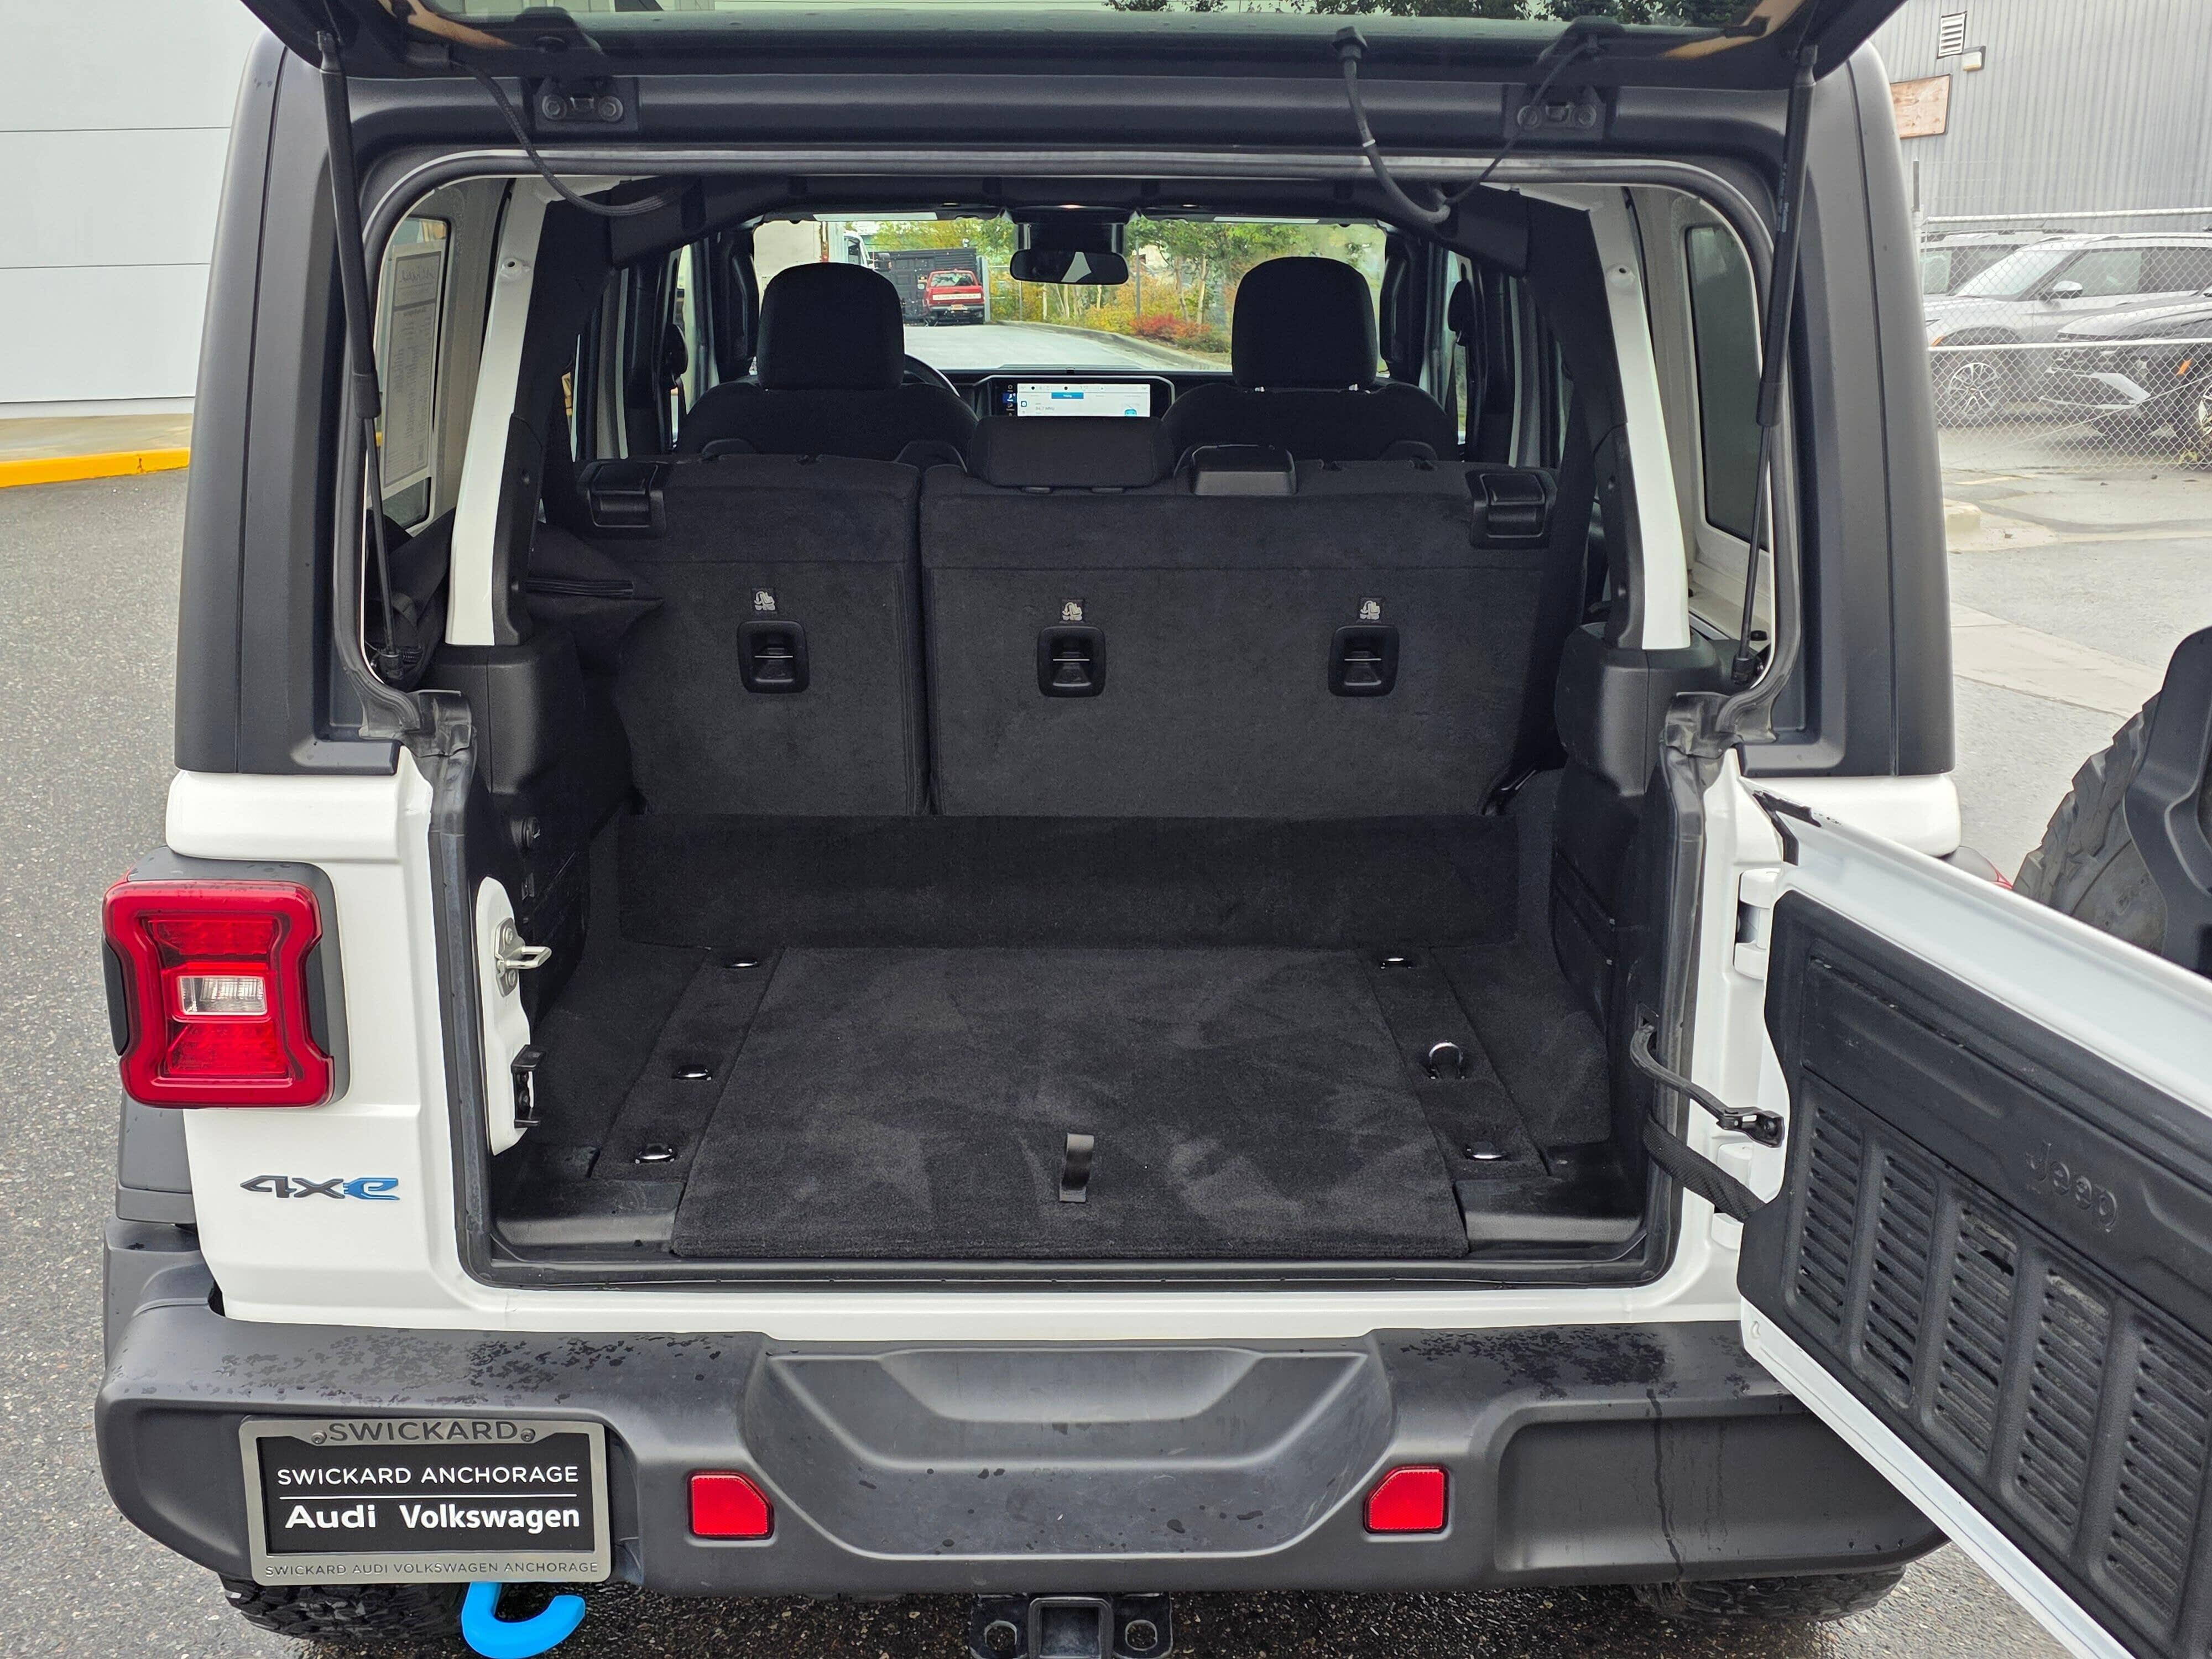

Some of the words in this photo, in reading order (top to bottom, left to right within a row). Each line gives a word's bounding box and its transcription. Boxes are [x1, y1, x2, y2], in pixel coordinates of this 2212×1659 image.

[2025, 1139, 2118, 1233] Jeep
[329, 1421, 518, 1442] SWICKARD
[277, 1467, 411, 1485] SWICKARD
[420, 1466, 579, 1484] ANCHORAGE
[285, 1505, 376, 1528] Audi
[399, 1504, 580, 1534] Volkswagen
[265, 1565, 347, 1577] SWICKARD
[352, 1564, 388, 1575] AUDI
[393, 1562, 499, 1574] VOLKSWAGEN
[504, 1562, 598, 1573] ANCHORAGE
